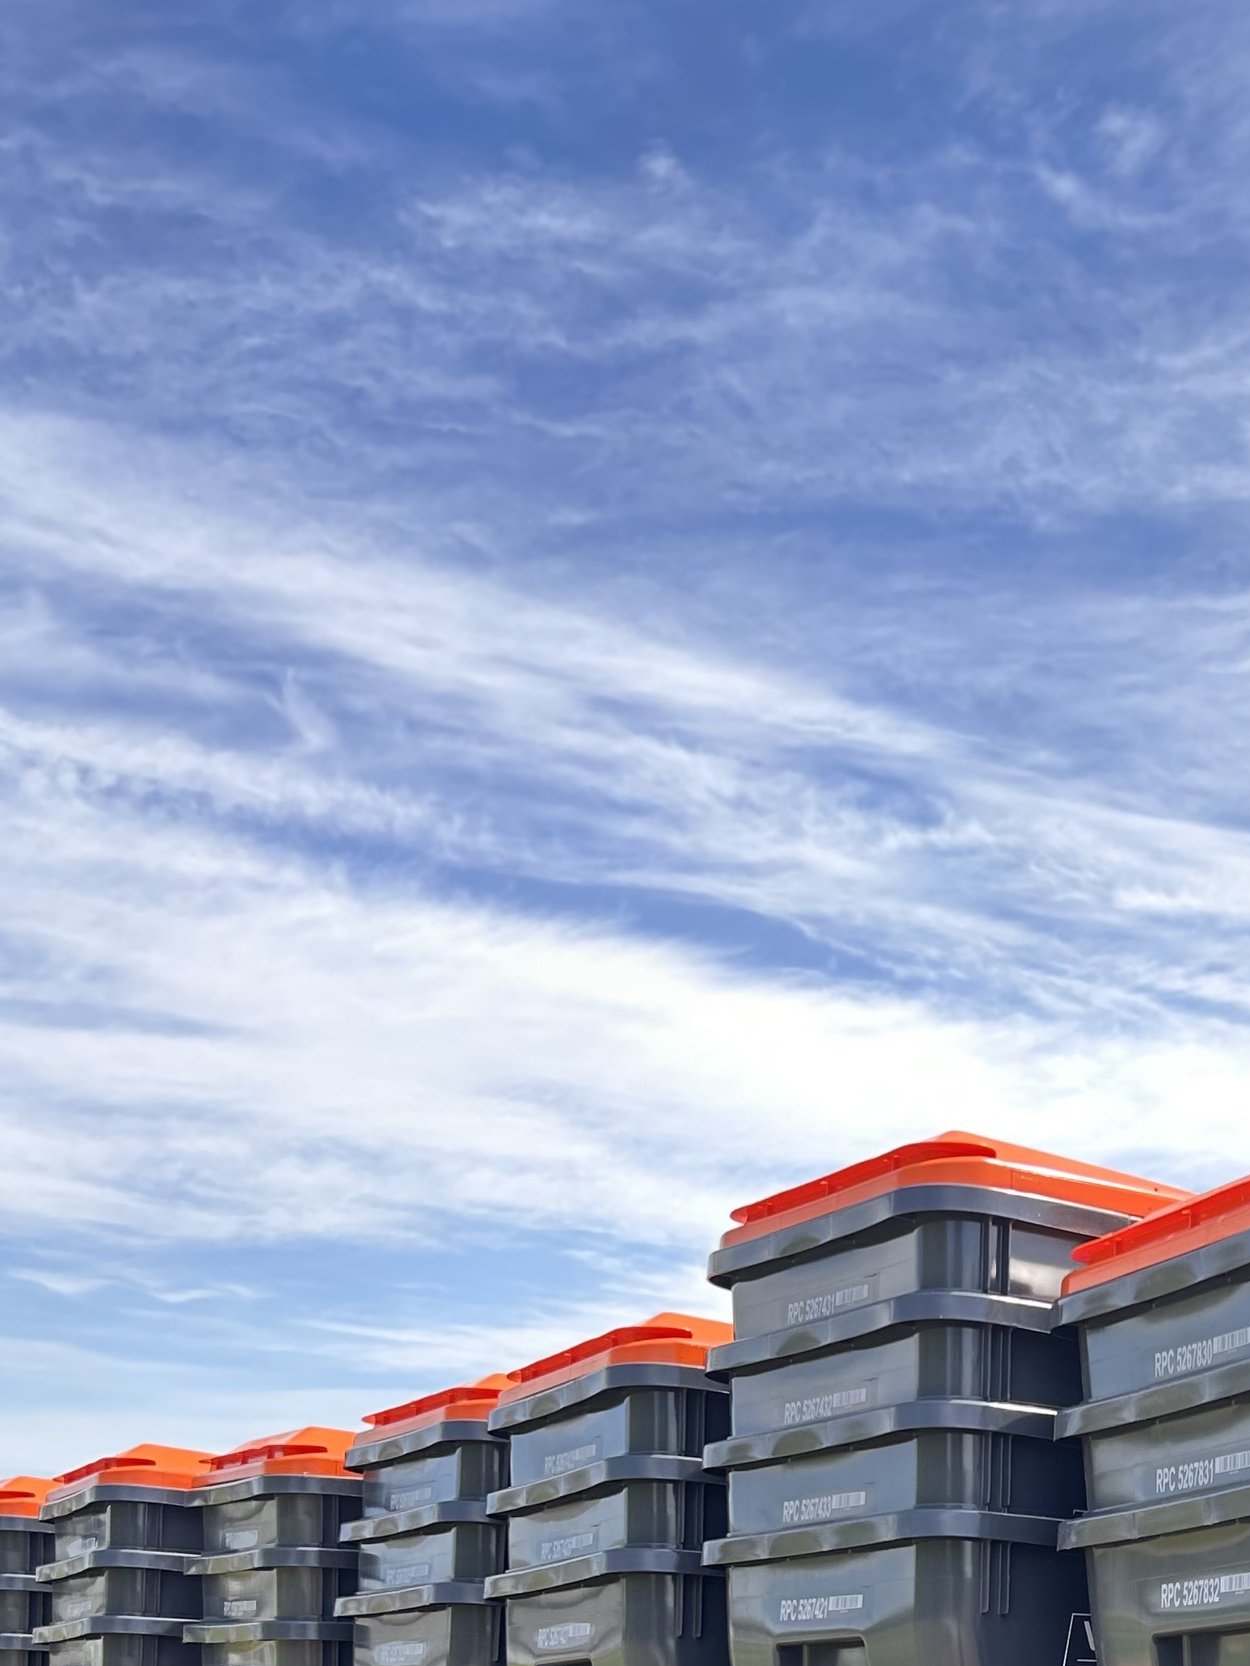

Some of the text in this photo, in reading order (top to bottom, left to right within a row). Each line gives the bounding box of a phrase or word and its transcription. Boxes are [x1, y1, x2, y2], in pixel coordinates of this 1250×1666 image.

[787, 1301, 804, 1326] RPC
[1154, 1338, 1213, 1377] RPC 5267830
[784, 1401, 801, 1425] RPC
[1156, 1458, 1214, 1493] RPC 5267831
[782, 1500, 800, 1523] RPC
[1160, 1577, 1220, 1609] RPC 5267832
[780, 1599, 798, 1621] RPC
